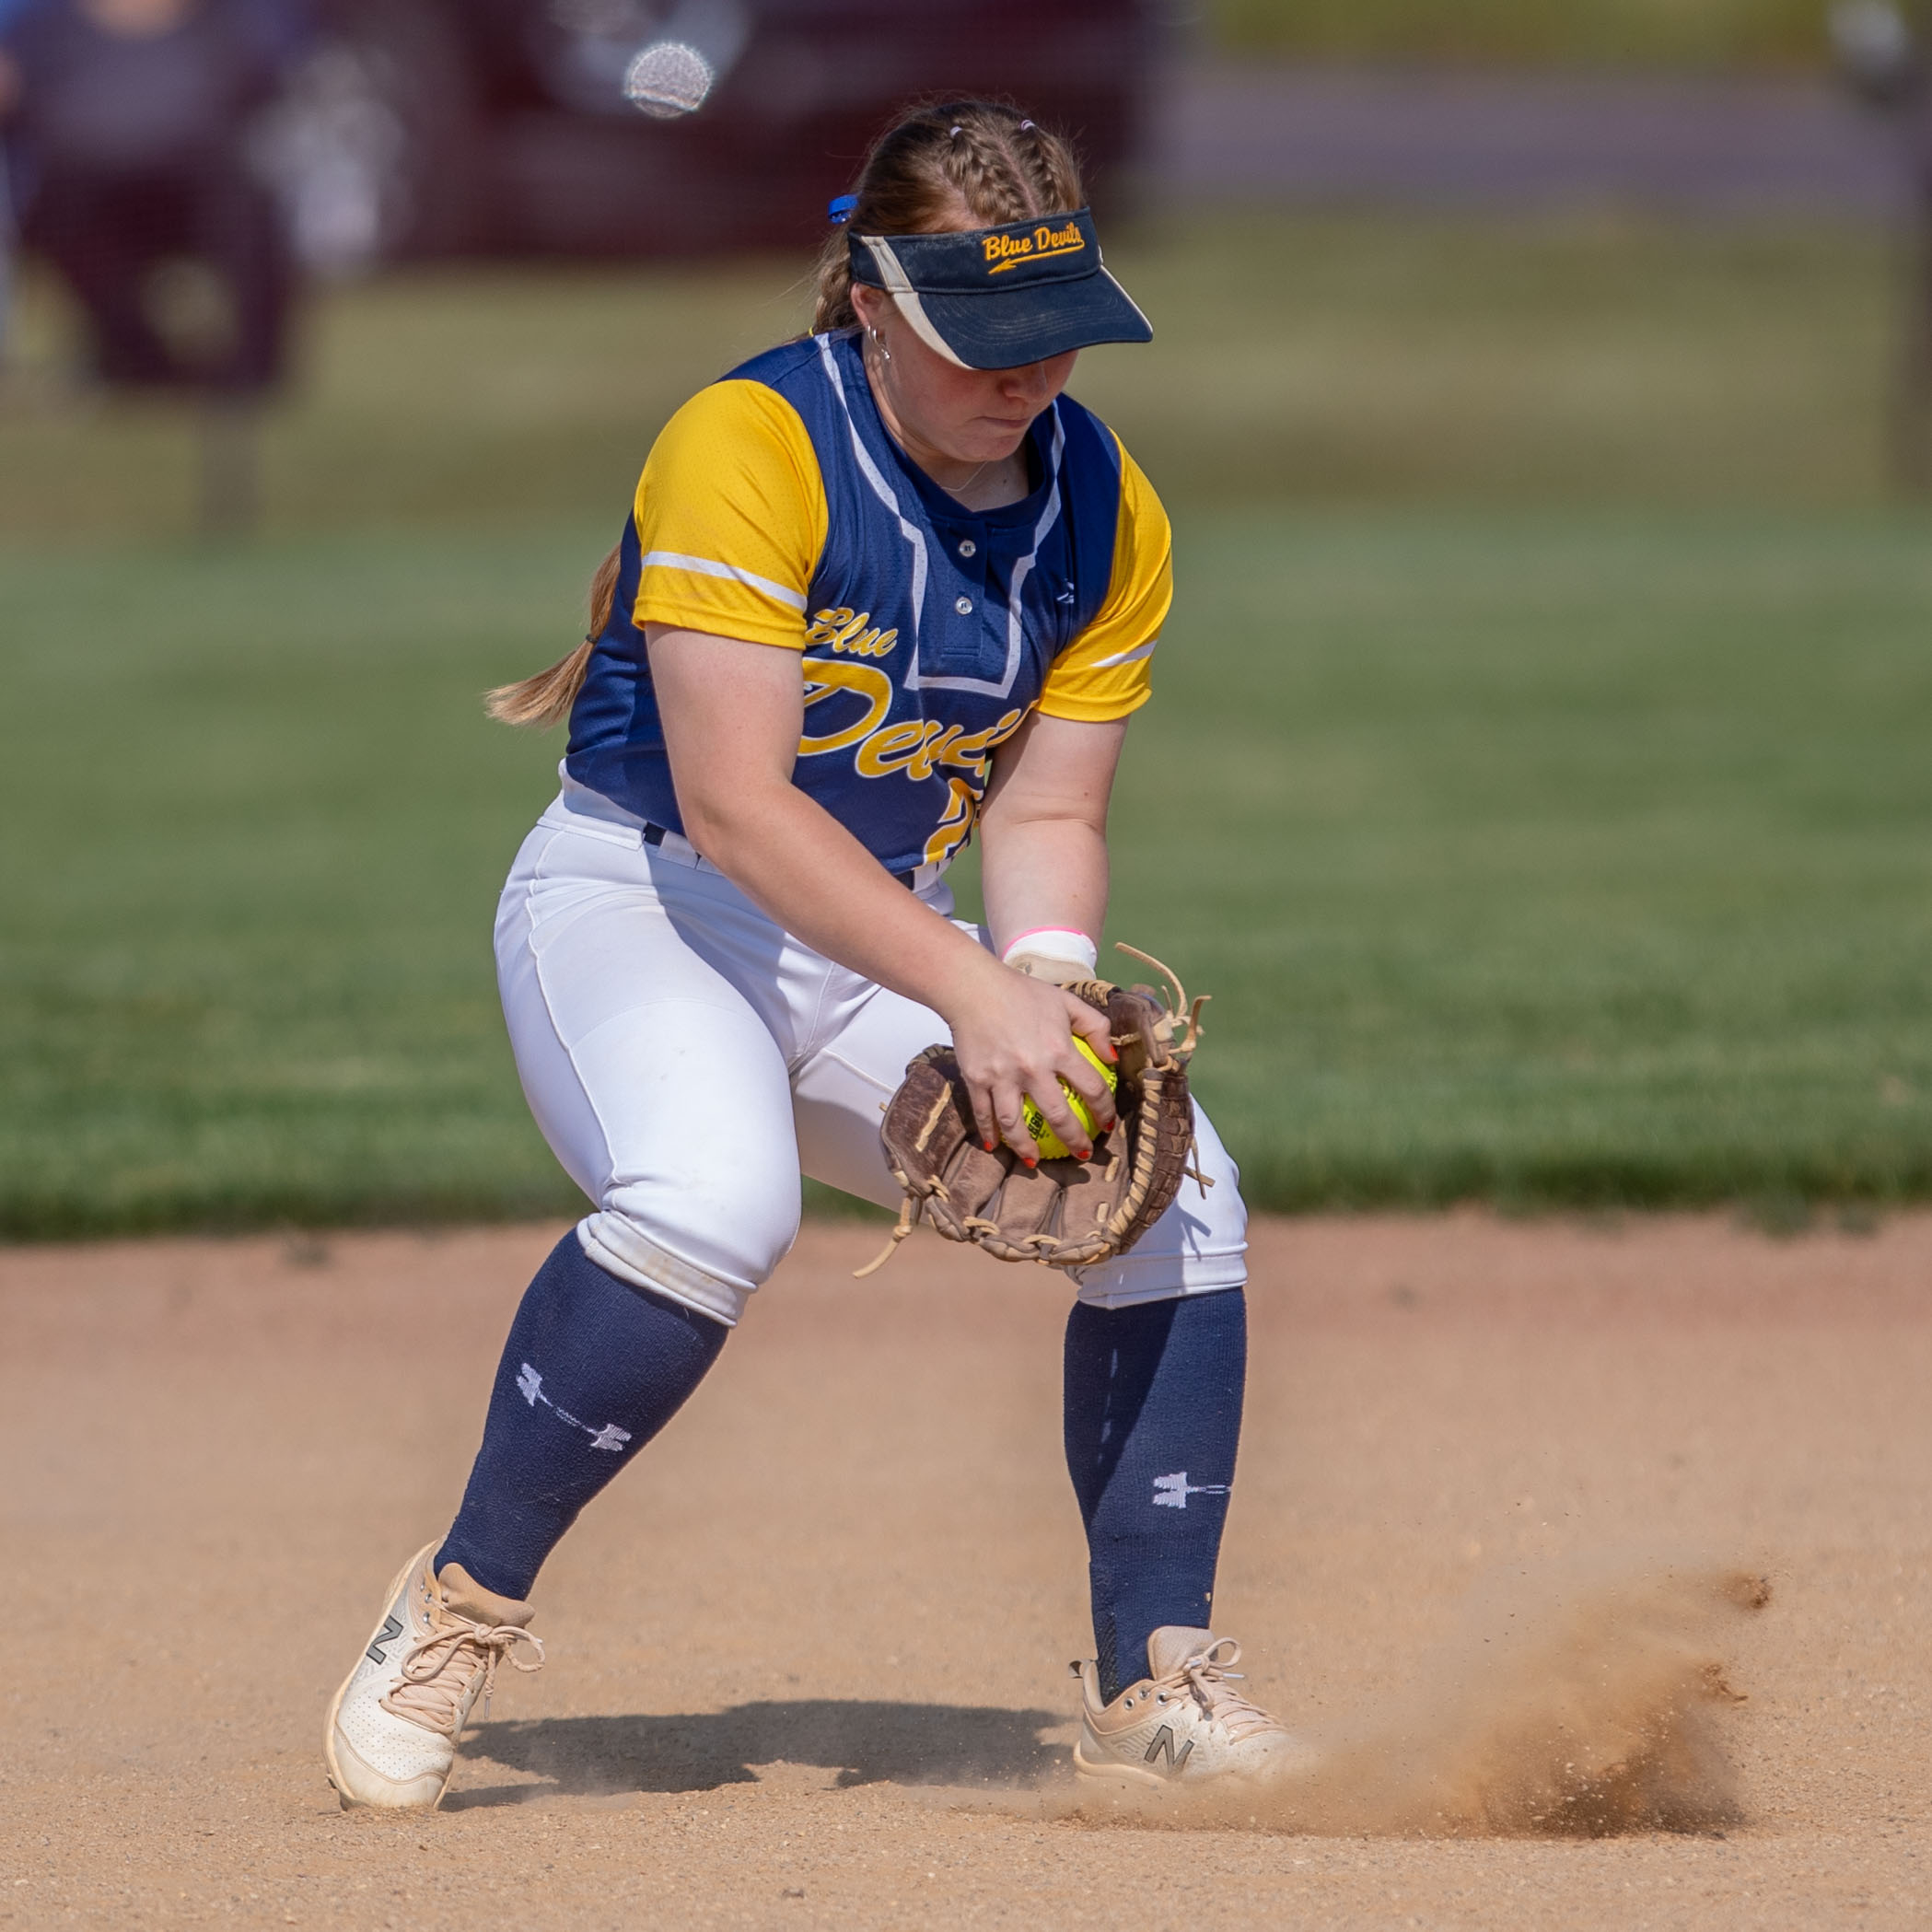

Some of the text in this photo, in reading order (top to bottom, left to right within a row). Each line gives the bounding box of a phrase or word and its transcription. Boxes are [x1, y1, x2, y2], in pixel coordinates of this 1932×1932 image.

[982, 221, 1084, 261] Blue Devils
[804, 607, 899, 658] Blue
[1144, 1724, 1194, 1775] N
